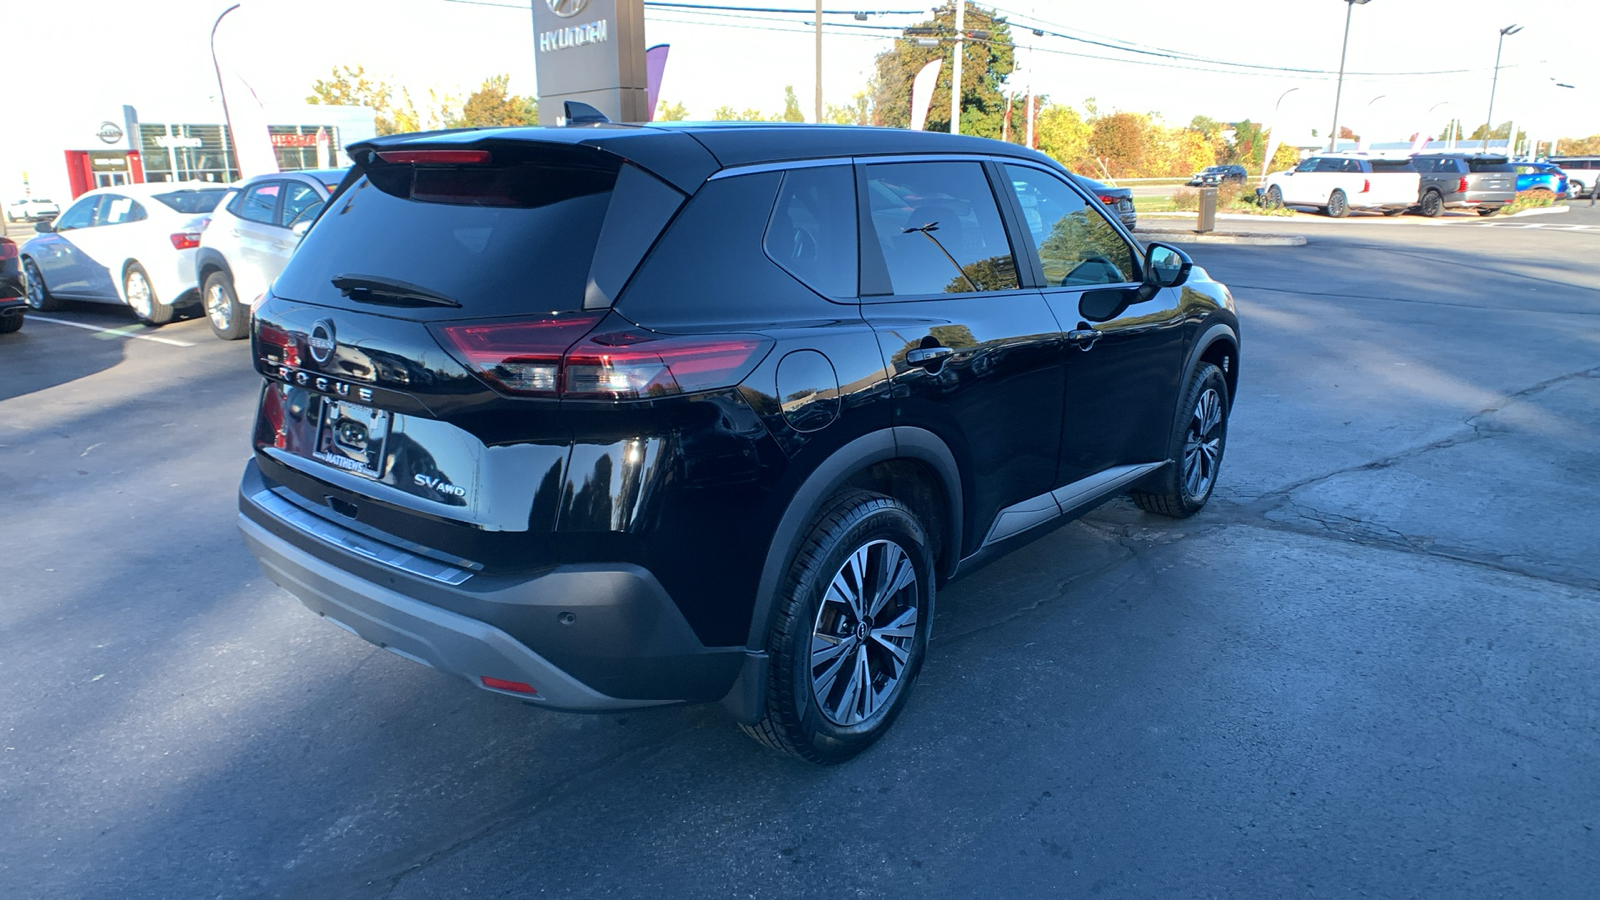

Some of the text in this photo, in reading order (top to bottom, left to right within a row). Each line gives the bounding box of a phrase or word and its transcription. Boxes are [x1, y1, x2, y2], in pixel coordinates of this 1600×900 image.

[540, 19, 607, 53] HYUNDAI
[279, 366, 374, 402] ROGUE
[325, 451, 364, 473] MATTHEWS
[414, 473, 466, 497] SV AWD
